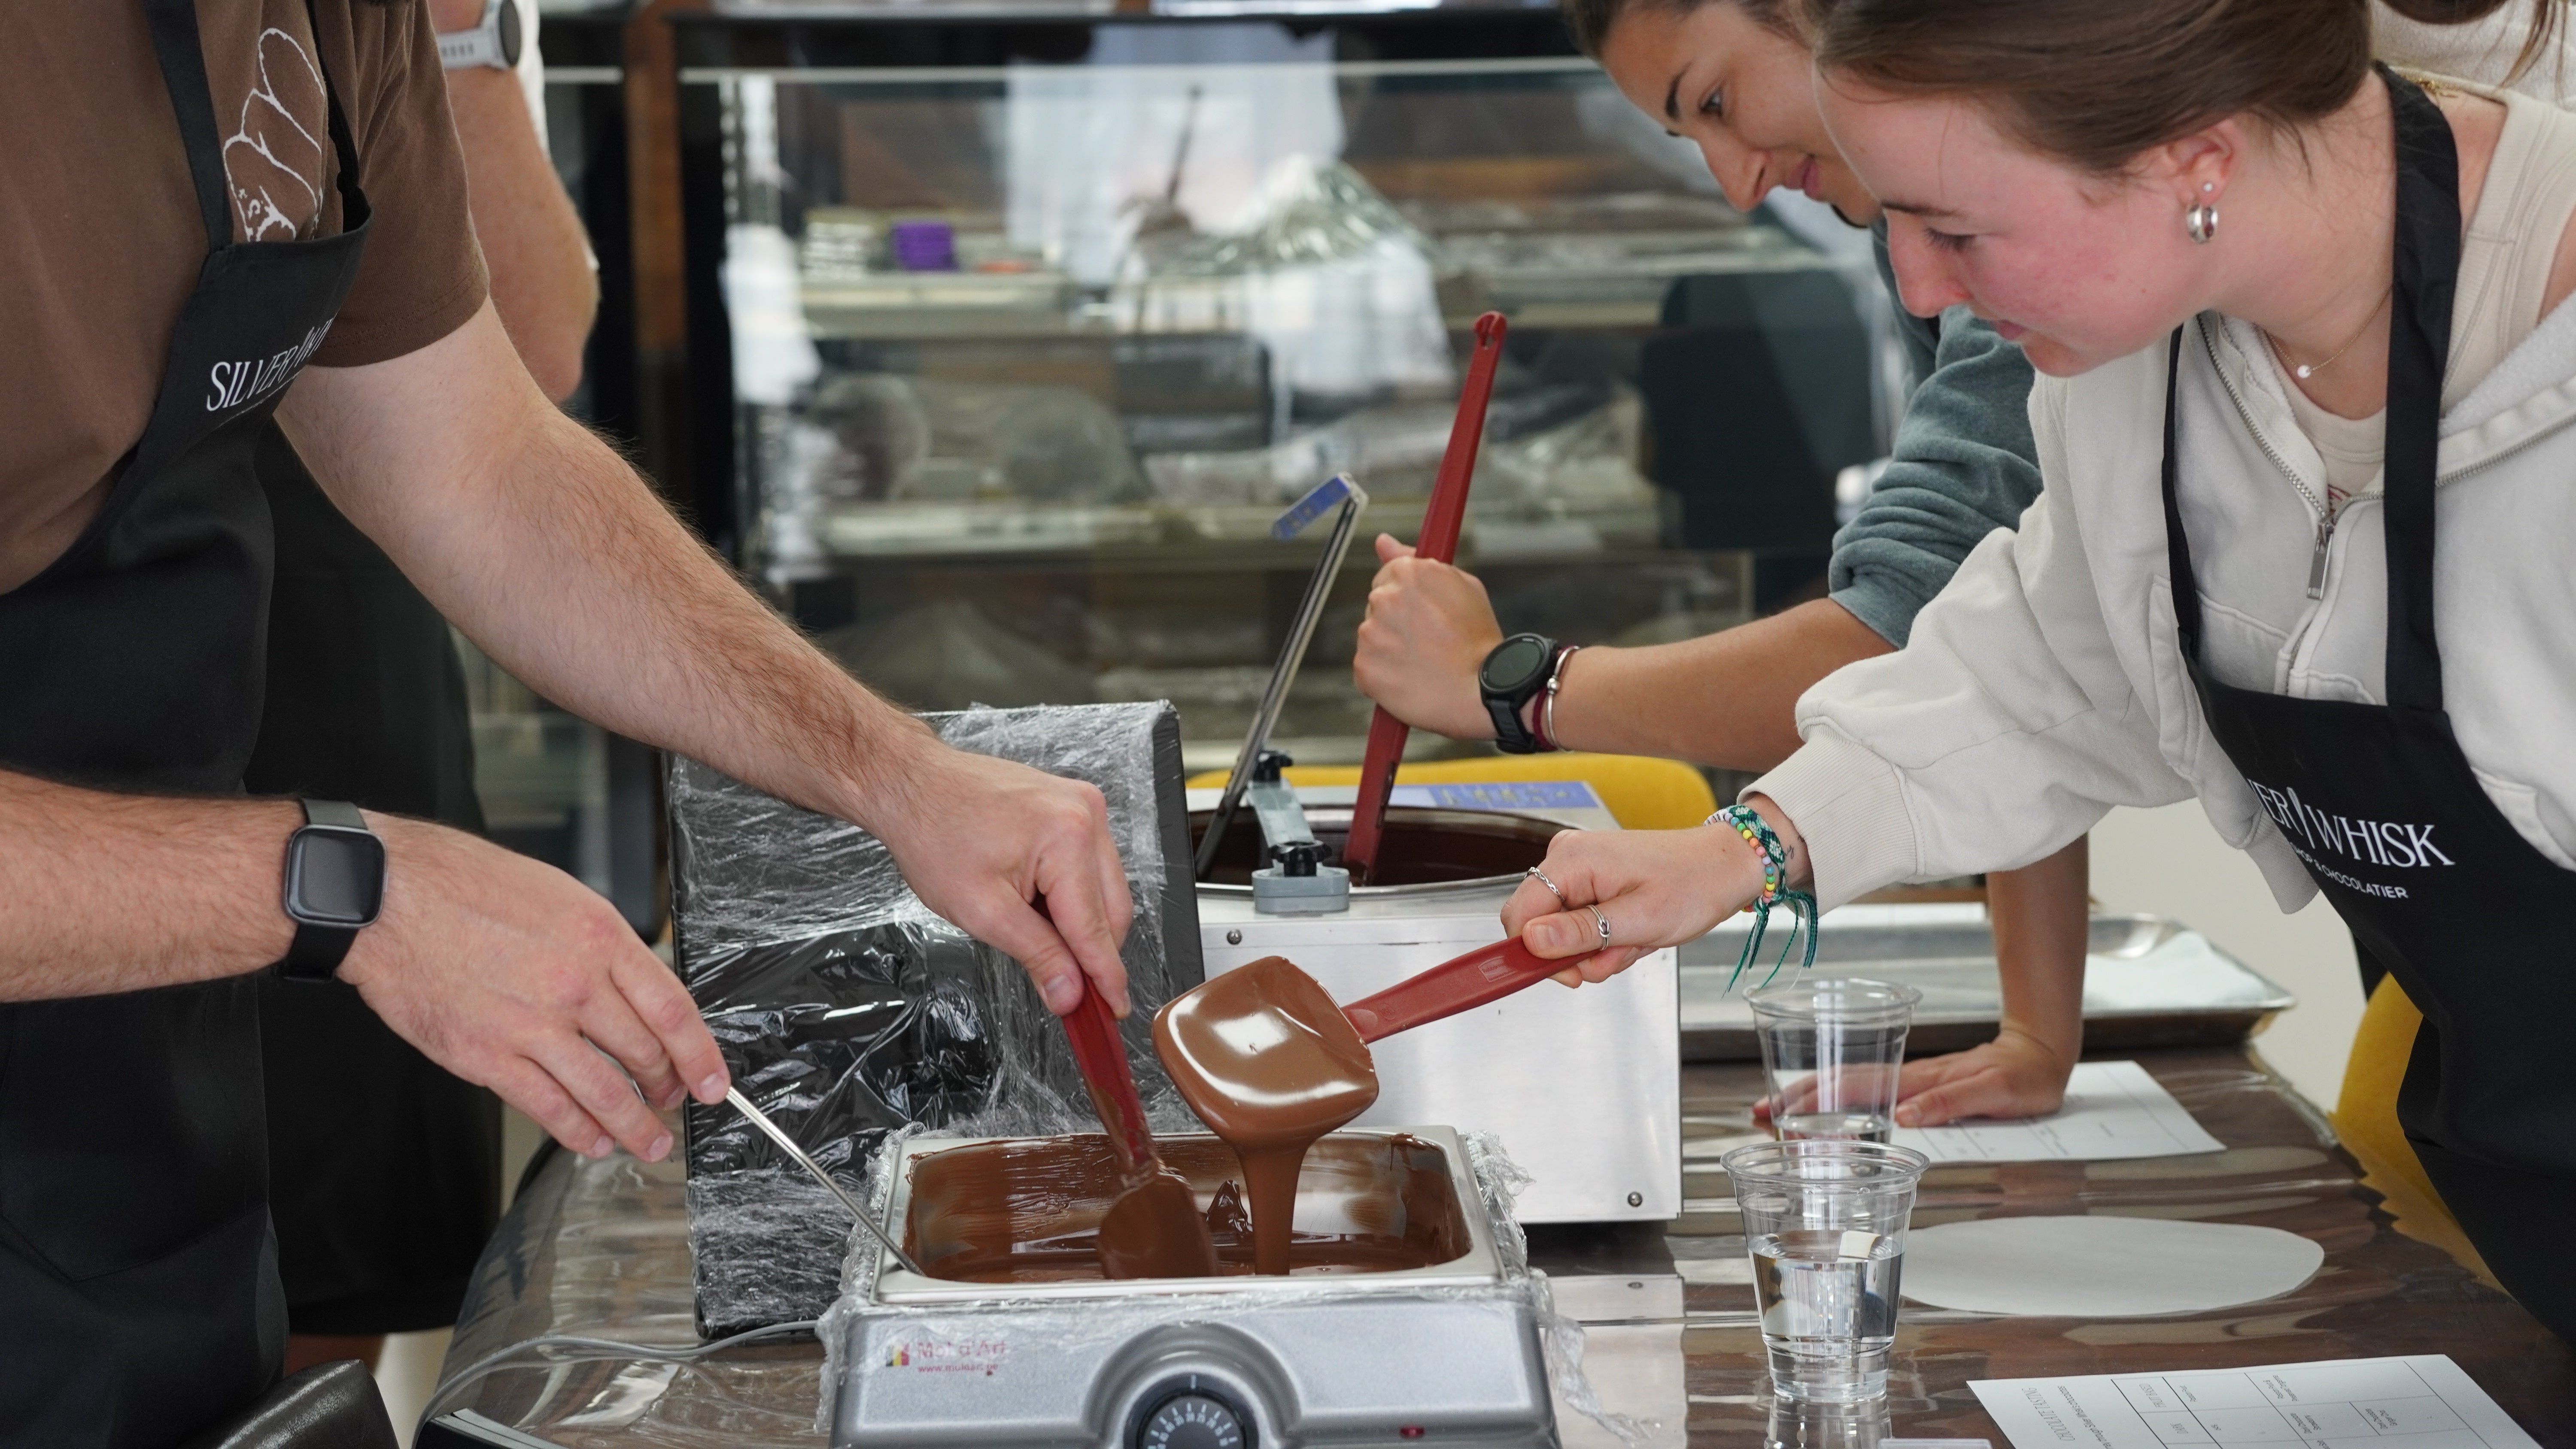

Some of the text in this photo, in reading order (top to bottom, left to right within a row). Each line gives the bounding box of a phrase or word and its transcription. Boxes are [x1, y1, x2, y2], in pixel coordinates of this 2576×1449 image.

[207, 345, 298, 412] SILVER
[2304, 804, 2455, 867] WHISK
[2321, 864, 2409, 899] CHOCOLATIER
[2021, 1388, 2075, 1441] CHOCOLATE TASTING
